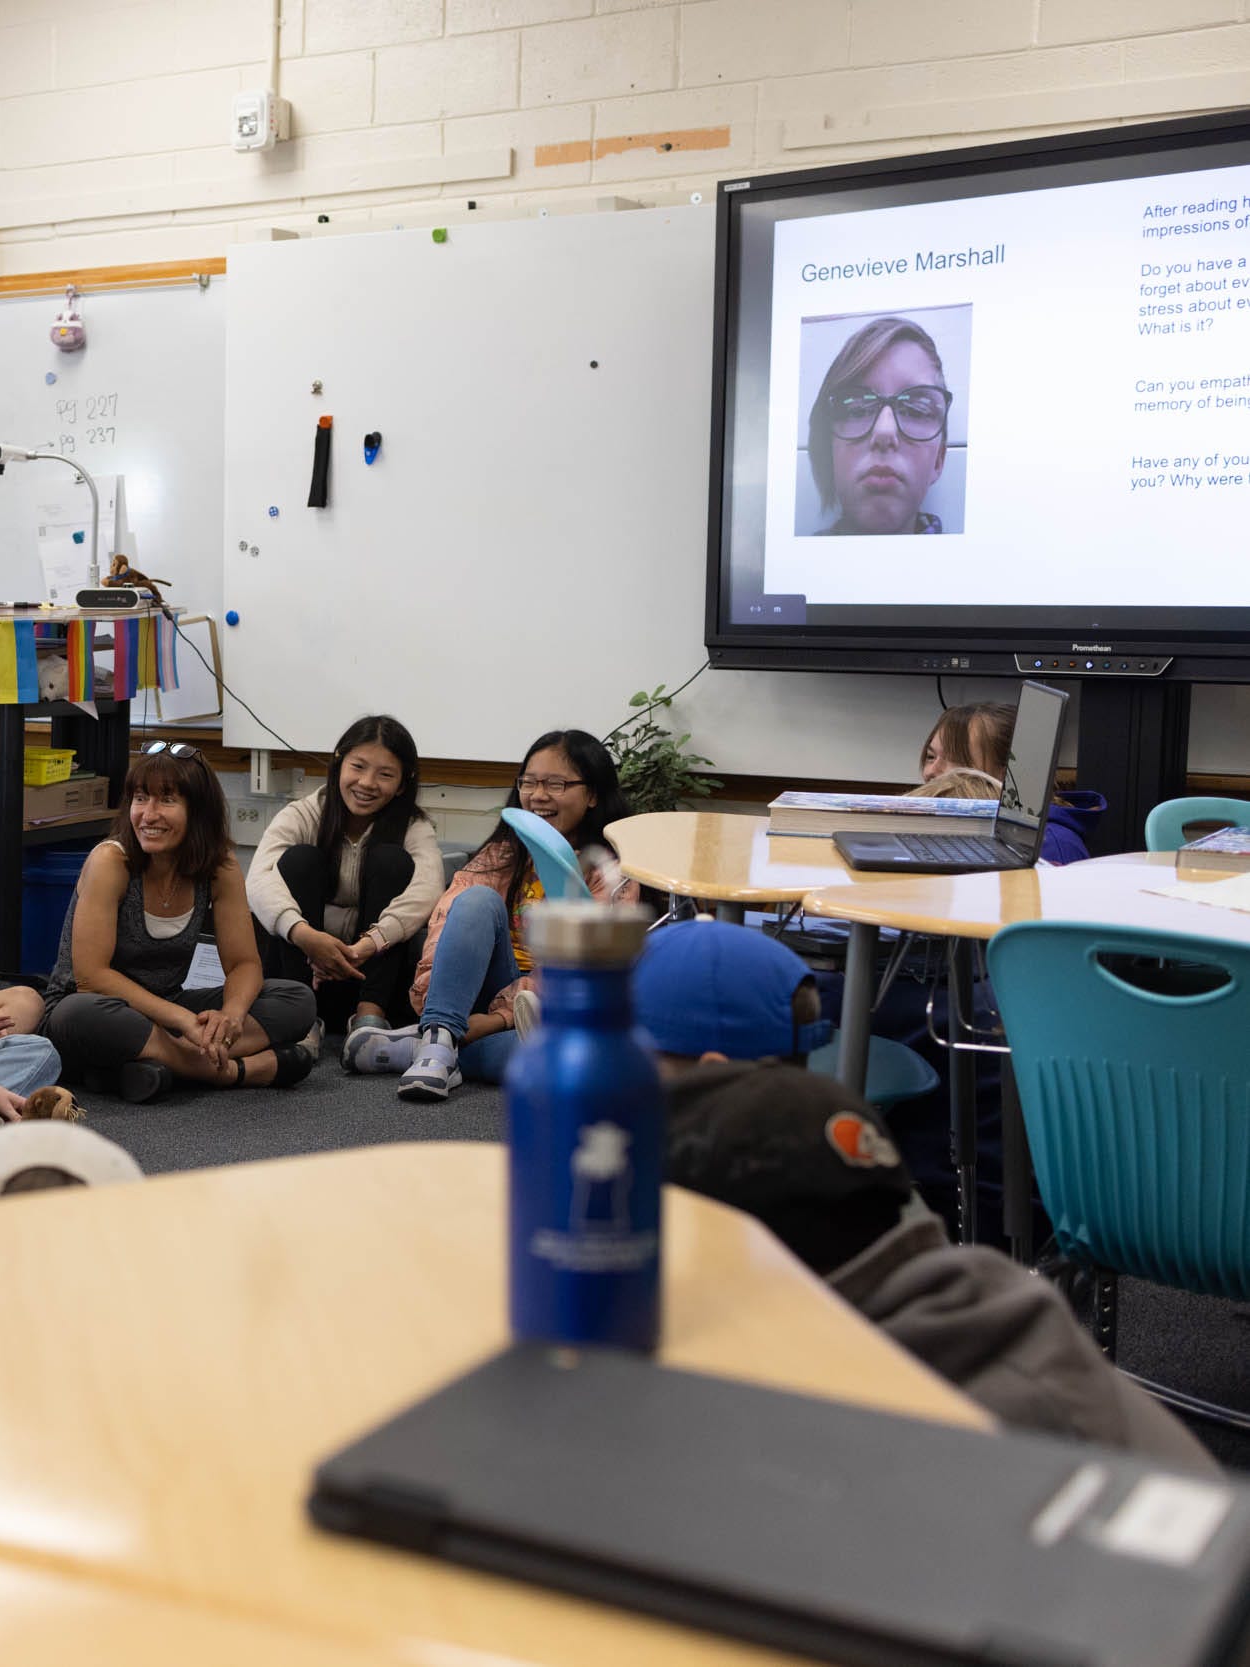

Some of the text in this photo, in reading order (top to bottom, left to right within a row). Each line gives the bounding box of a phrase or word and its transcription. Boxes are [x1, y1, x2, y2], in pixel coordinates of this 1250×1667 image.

[1143, 204, 1178, 219] After
[1182, 199, 1238, 215] reading
[1142, 214, 1250, 239] impressions of
[801, 243, 1005, 283] Genevieve Marshall
[1141, 257, 1247, 278] Do you have a
[1140, 282, 1181, 298] forget
[1186, 278, 1227, 293] about
[1139, 303, 1183, 317] stress
[1188, 298, 1231, 312] about
[1138, 317, 1214, 336] What is it?
[1135, 379, 1164, 393] Can
[1169, 380, 1195, 394] you
[85, 391, 118, 420] 227
[1134, 400, 1192, 413] memory
[1197, 395, 1212, 409] of
[59, 427, 116, 455] pg 237
[1132, 453, 1249, 470] Have any of you
[1131, 474, 1243, 491] you? Why were
[1072, 643, 1112, 652] Promethean
